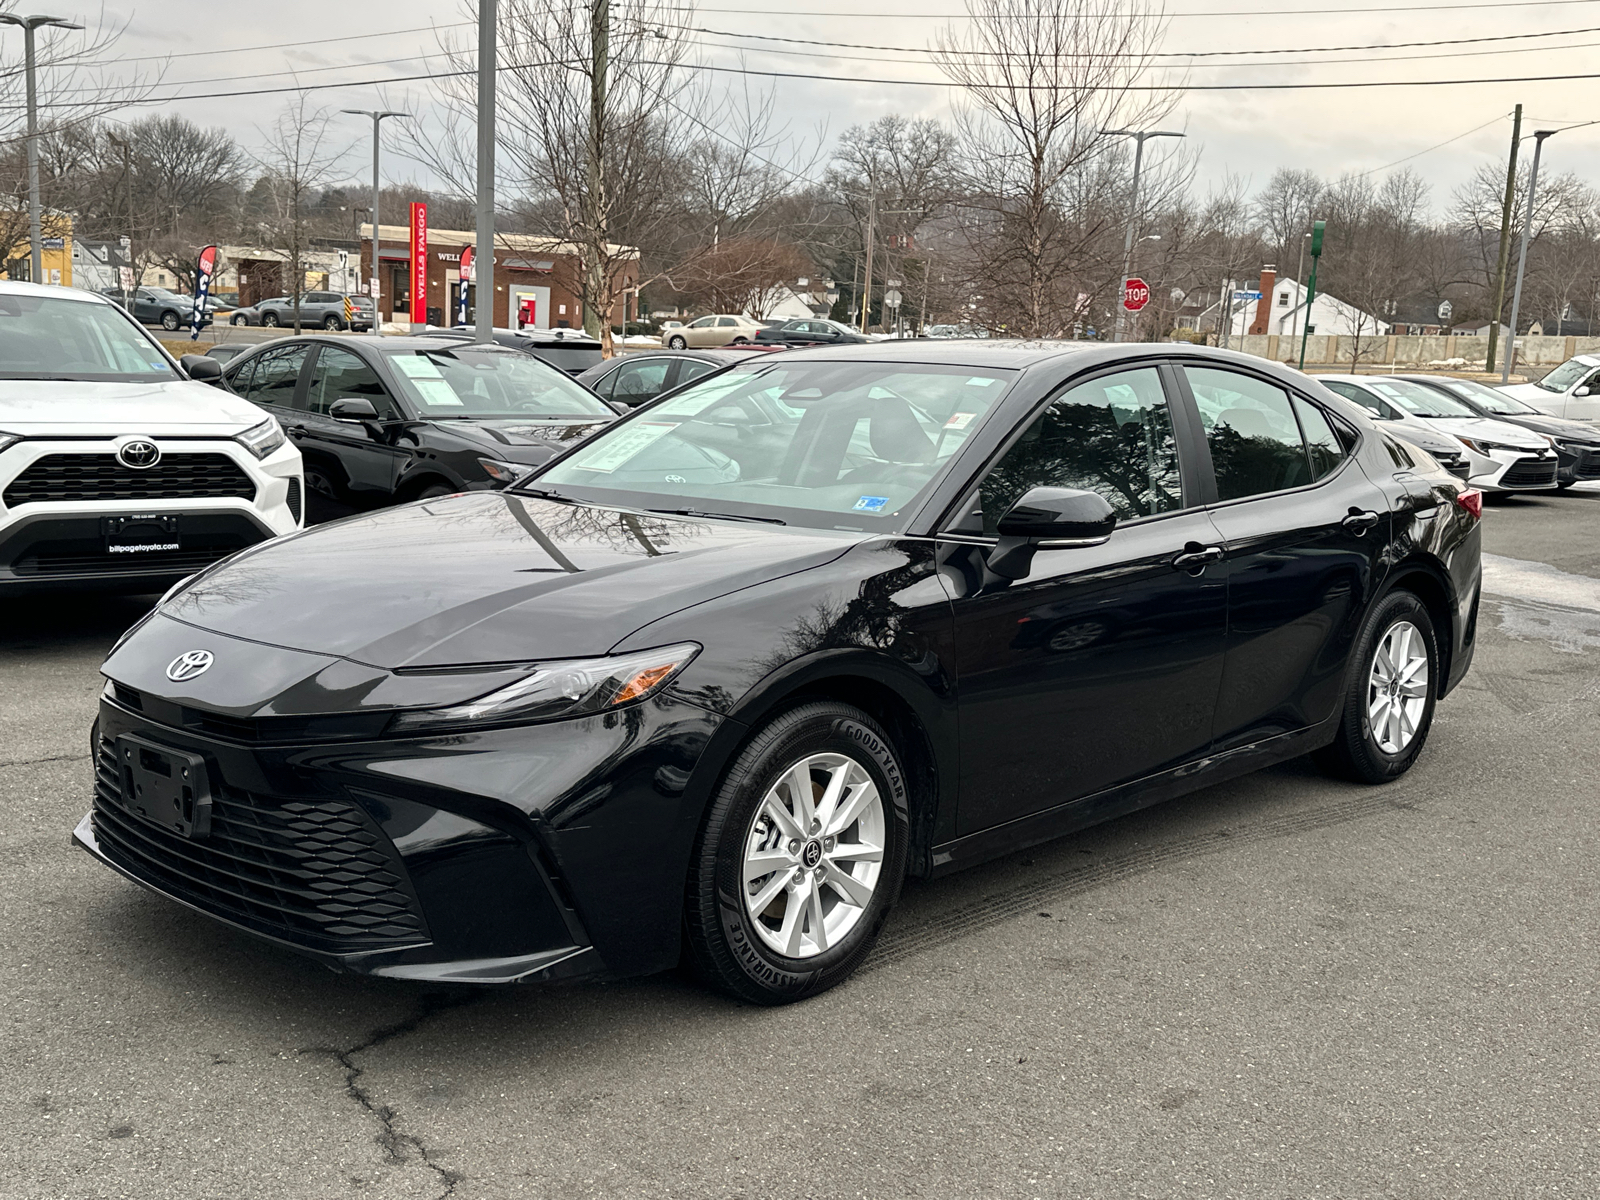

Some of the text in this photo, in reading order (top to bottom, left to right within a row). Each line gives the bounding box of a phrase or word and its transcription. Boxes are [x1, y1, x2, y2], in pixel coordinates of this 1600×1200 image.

[418, 207, 426, 300] WELLS FARGO
[438, 252, 461, 262] WELL
[109, 543, 179, 553] billpagetoyota.com
[845, 724, 904, 799] GOODYEAR
[729, 921, 799, 987] ASSURANCE
